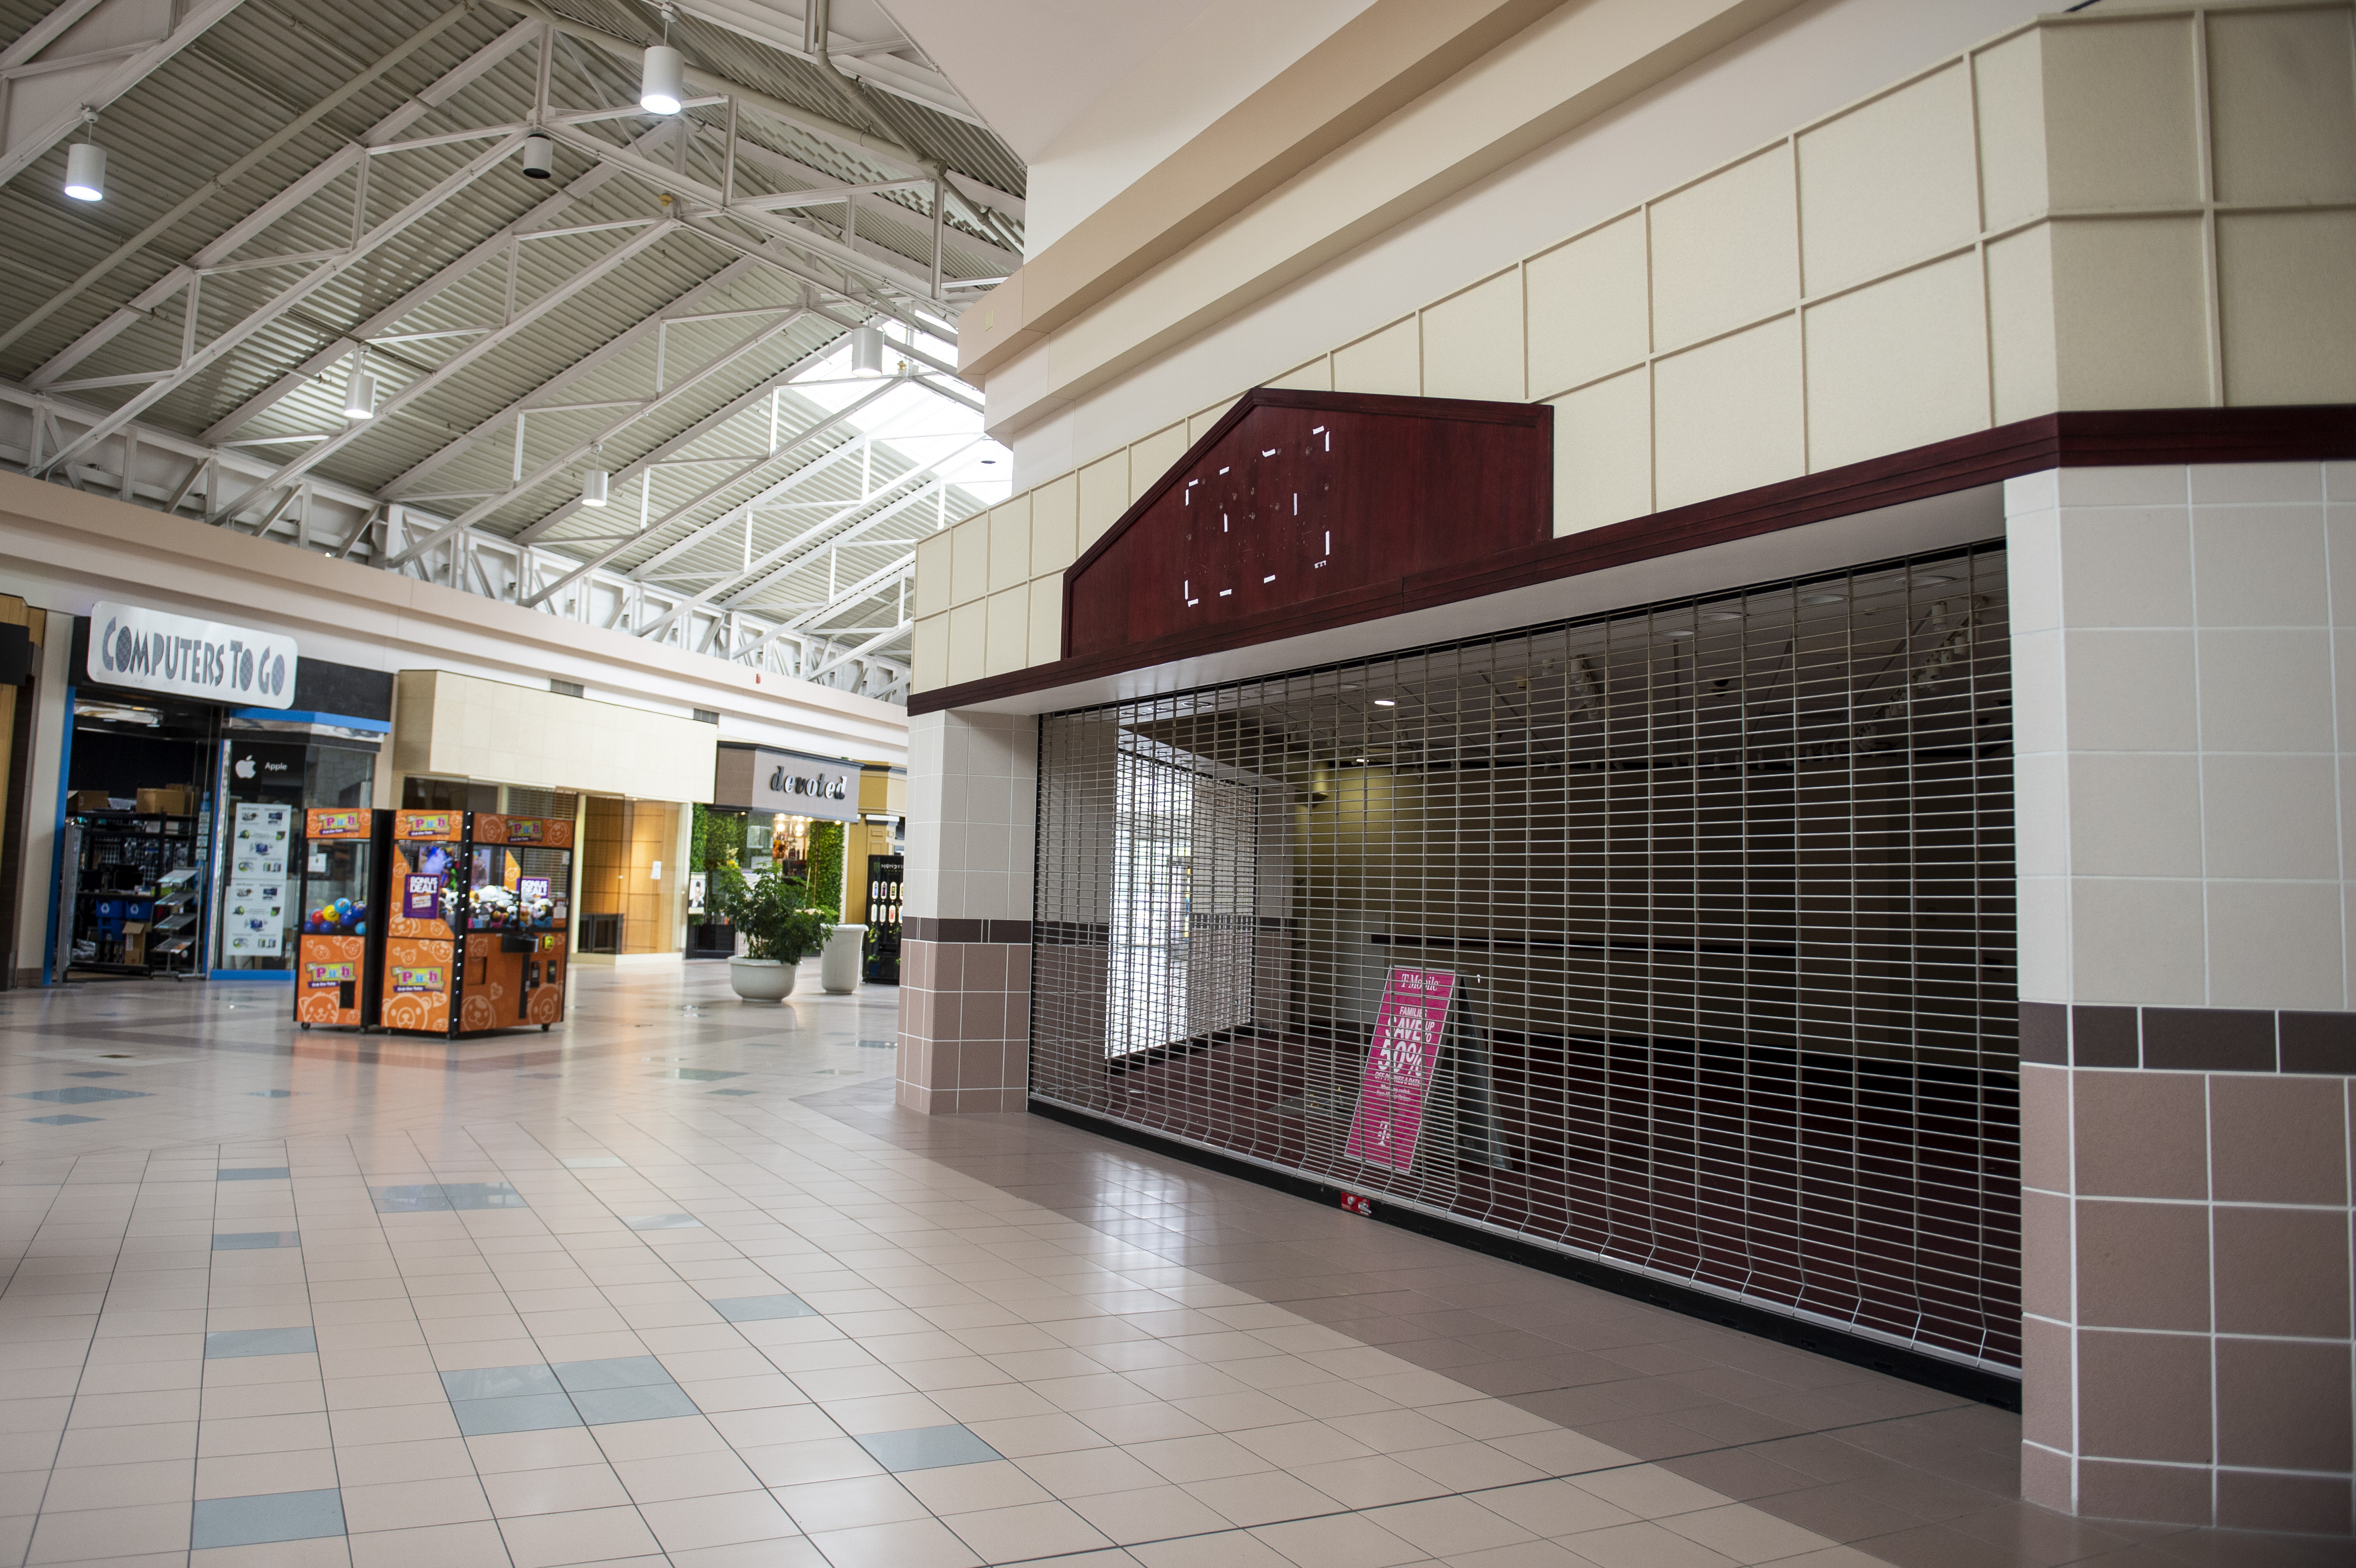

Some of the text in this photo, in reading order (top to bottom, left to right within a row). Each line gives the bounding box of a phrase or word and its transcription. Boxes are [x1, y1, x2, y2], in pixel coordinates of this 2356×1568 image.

[102, 616, 285, 697] COMPUTERS TO GO
[264, 761, 288, 772] Apple
[771, 765, 848, 800] devoted
[410, 876, 438, 885] BONUS
[410, 883, 438, 894] DEAL!
[1385, 1016, 1423, 1041] SAVE
[1424, 1020, 1435, 1031] UP
[1377, 1038, 1423, 1077] 50%
